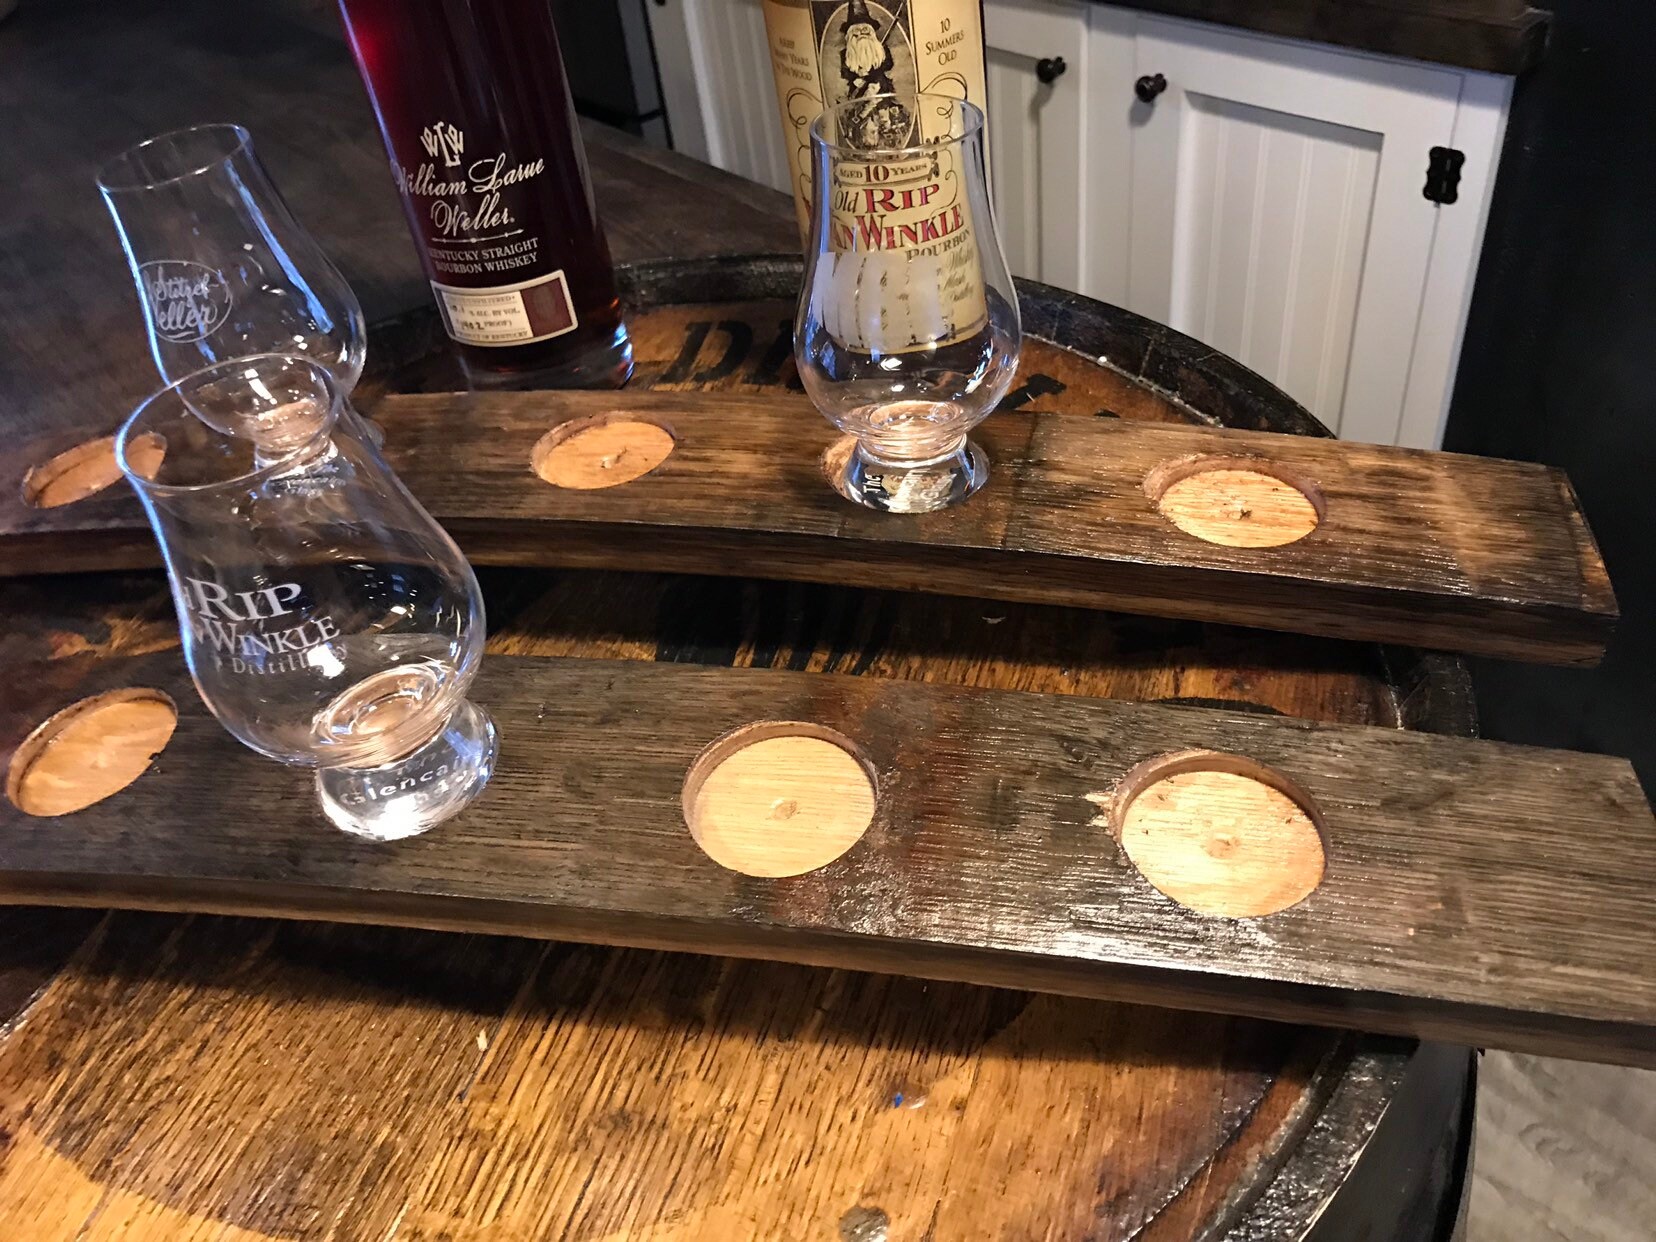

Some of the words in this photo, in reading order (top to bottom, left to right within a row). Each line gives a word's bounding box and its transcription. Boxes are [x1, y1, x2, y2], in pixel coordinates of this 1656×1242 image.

[940, 18, 951, 32] 10
[925, 30, 965, 56] SUMMERS
[938, 51, 958, 66] OLD
[468, 152, 545, 193] Larue
[839, 168, 863, 179] AGED
[864, 165, 889, 183] 10
[890, 163, 928, 177] YEARS
[834, 190, 859, 214] Old
[863, 183, 940, 214] RIP
[855, 203, 964, 251] WINKLE
[481, 237, 539, 260] STRAIGHT
[434, 260, 483, 274] BOURBON
[484, 251, 538, 273] WHISKEY
[186, 576, 302, 621] RIP
[200, 615, 341, 655] WINKLE
